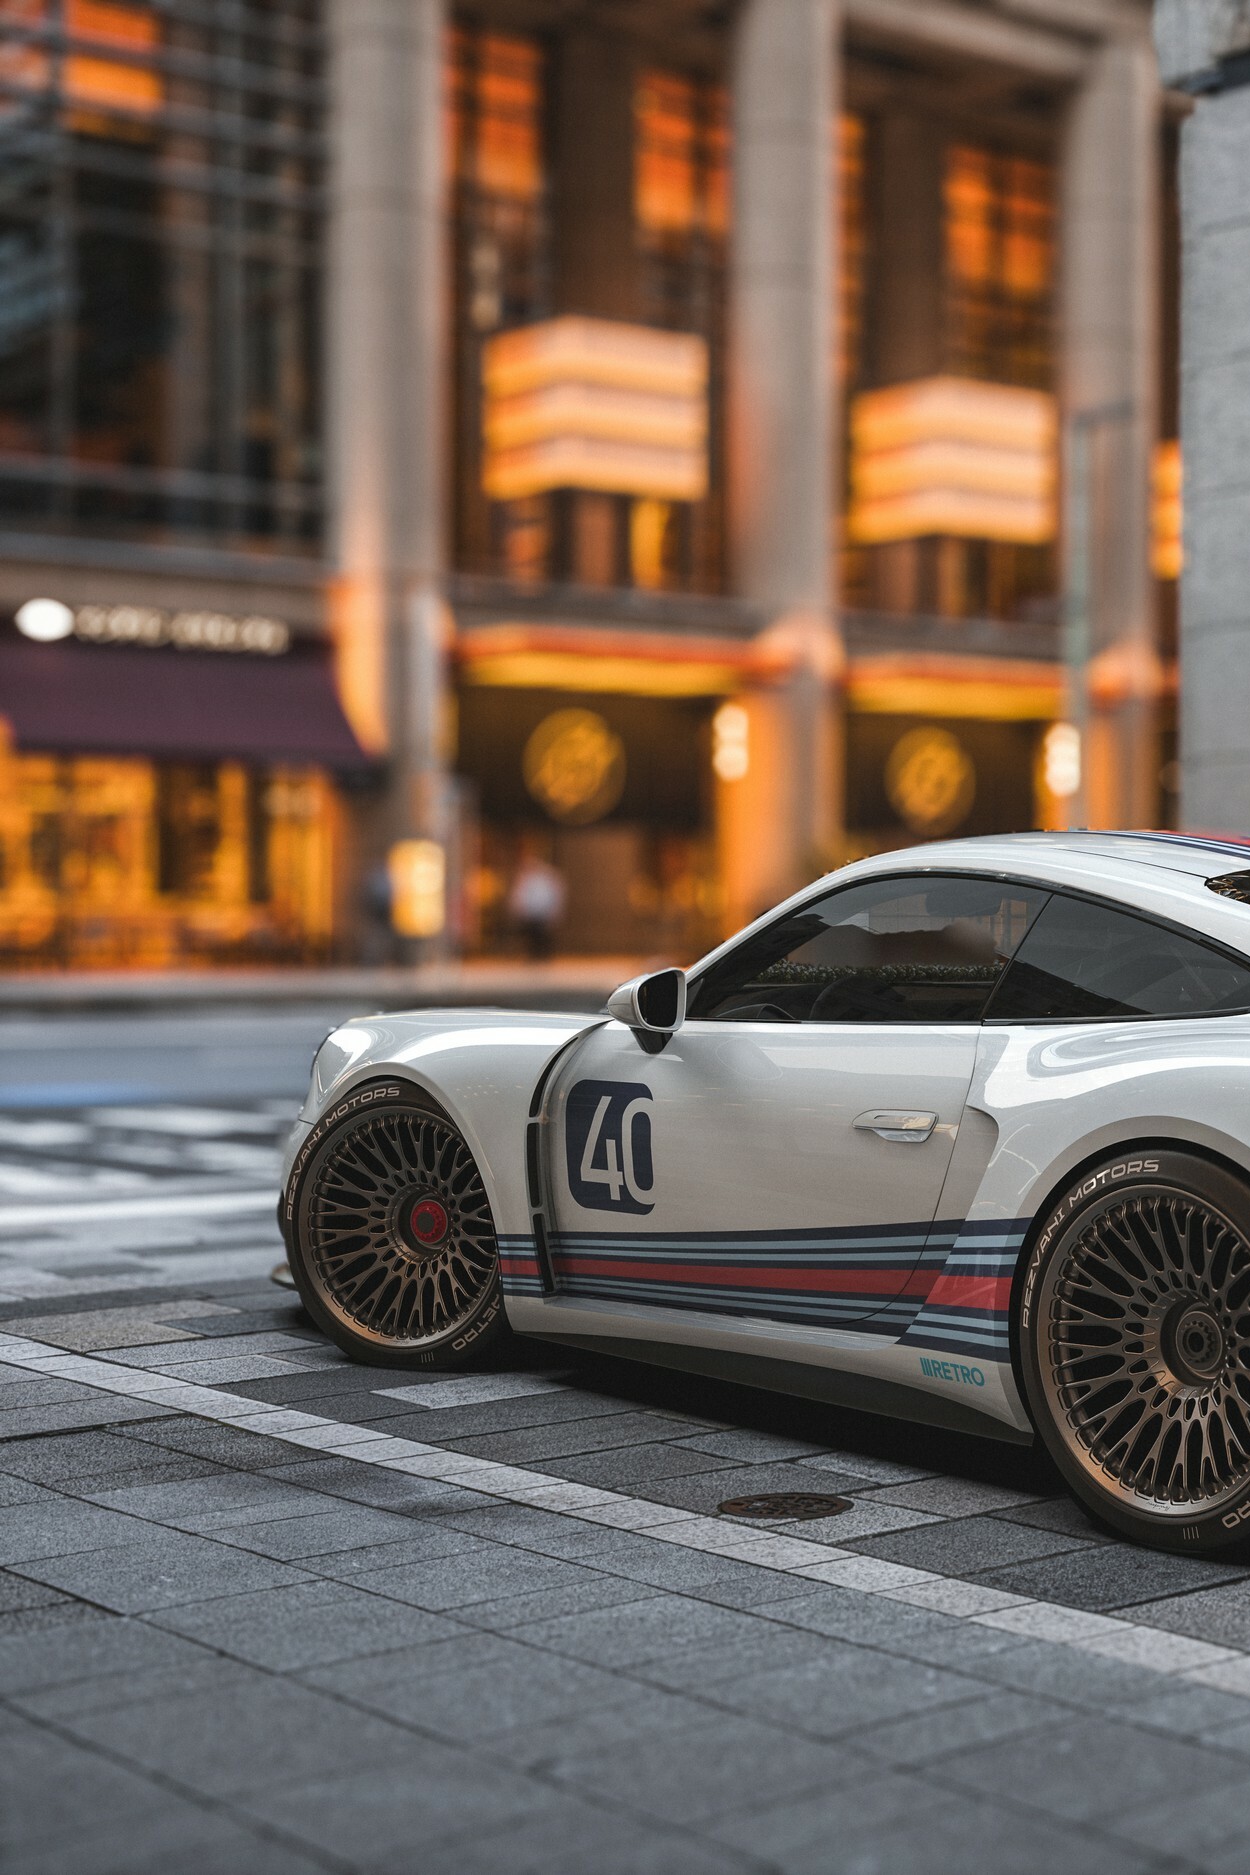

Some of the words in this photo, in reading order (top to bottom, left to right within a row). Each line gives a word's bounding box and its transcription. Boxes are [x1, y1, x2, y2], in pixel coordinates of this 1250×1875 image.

[325, 1086, 401, 1127] MOTORS
[580, 1095, 657, 1205] 40
[1068, 1159, 1160, 1208] MOTORS
[451, 1293, 500, 1351] RETRO
